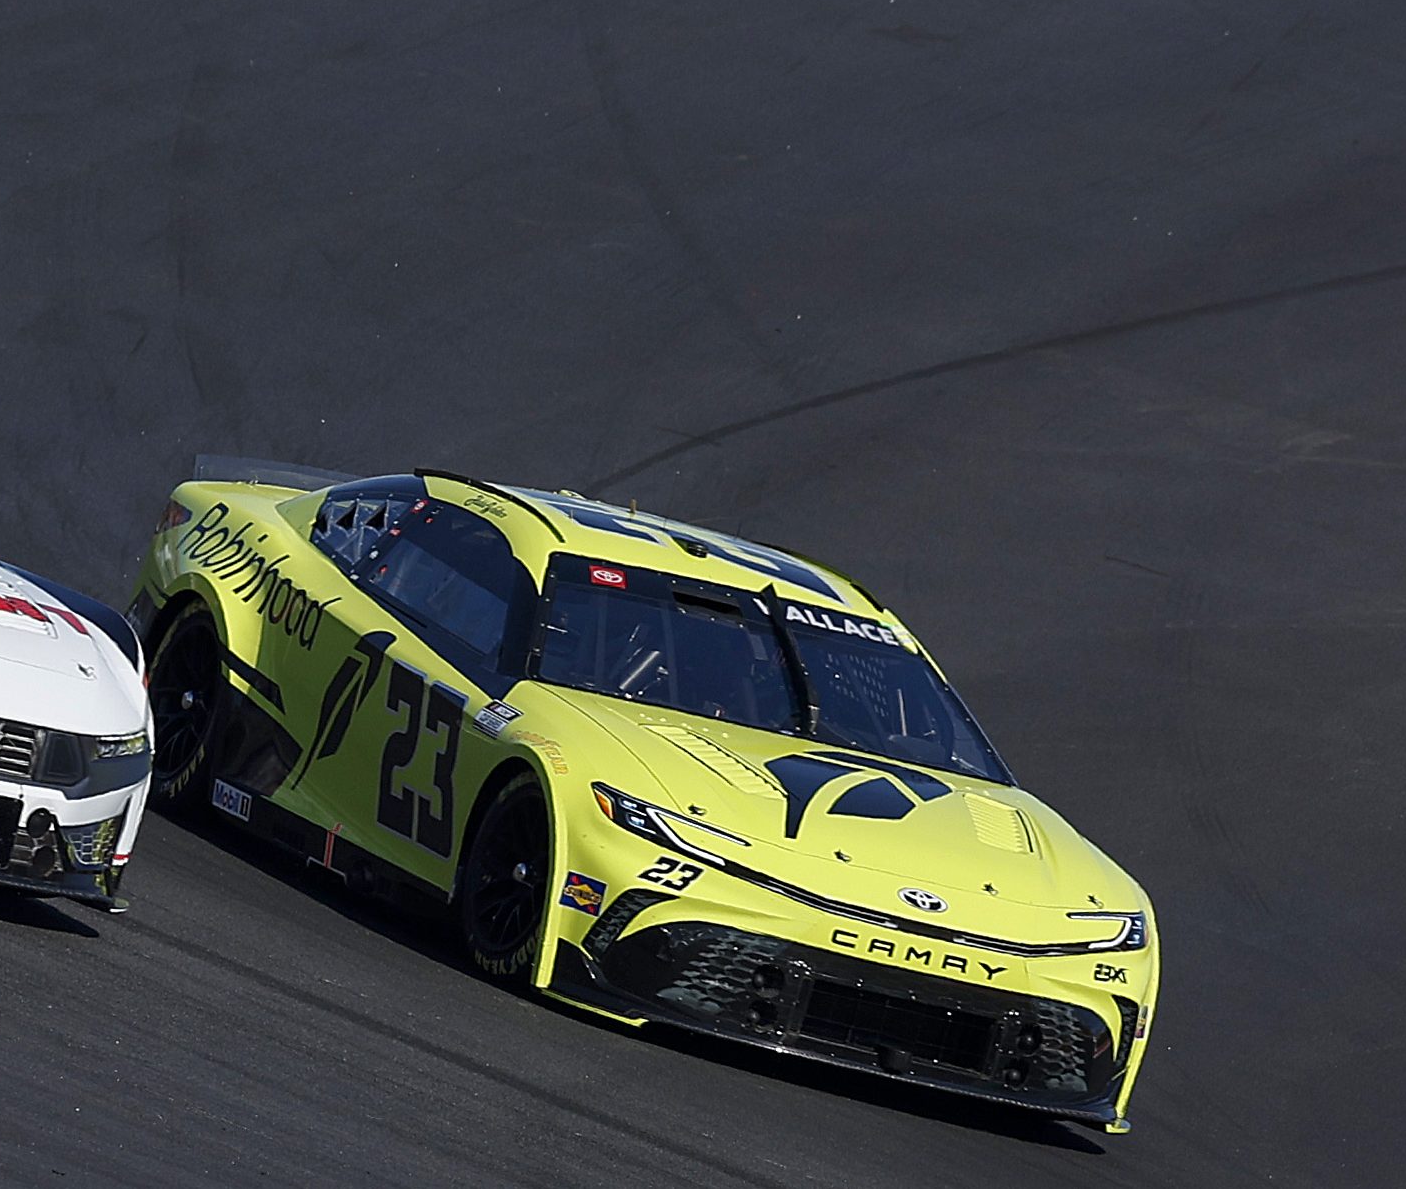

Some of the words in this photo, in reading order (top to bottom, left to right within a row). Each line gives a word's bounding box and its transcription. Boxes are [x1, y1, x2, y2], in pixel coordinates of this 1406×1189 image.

[176, 501, 343, 651] Robinhood
[377, 658, 469, 861] 23
[638, 854, 705, 893] 23
[831, 928, 1009, 980] CAMRY
